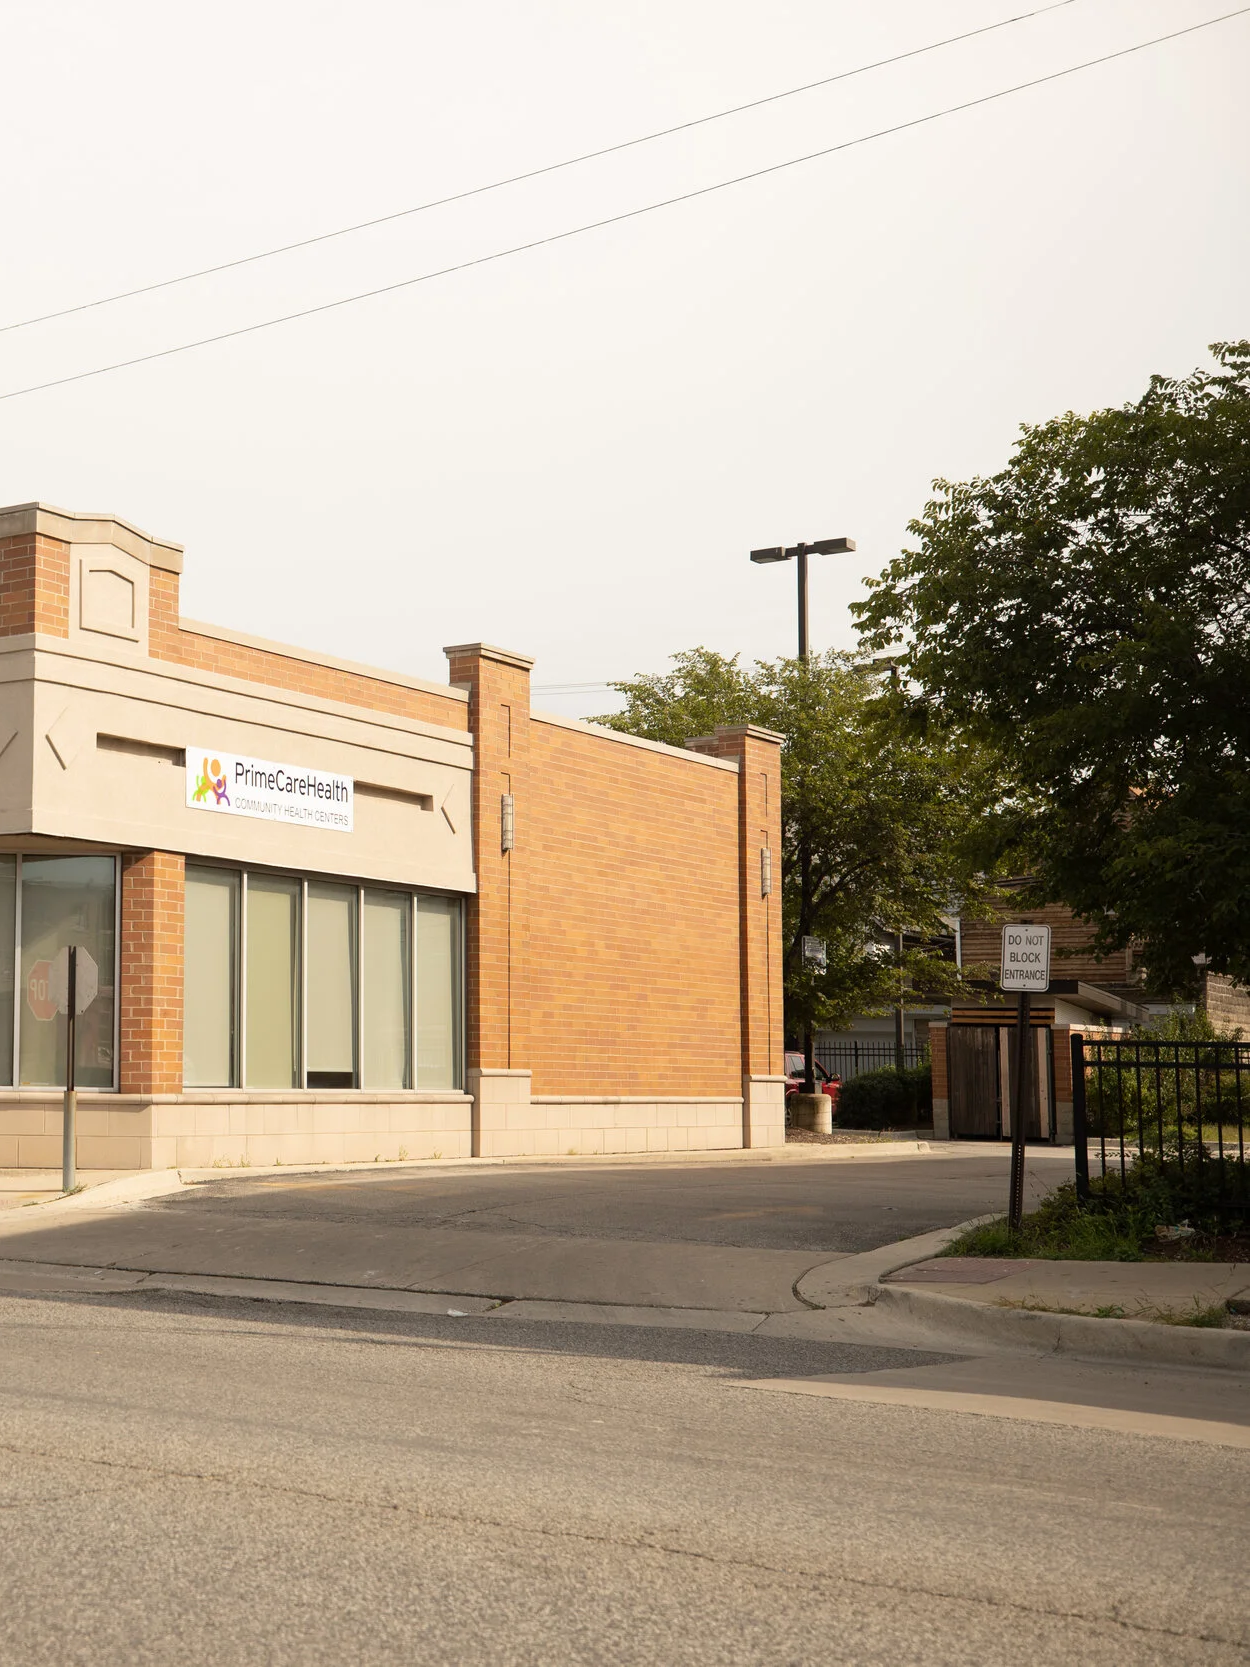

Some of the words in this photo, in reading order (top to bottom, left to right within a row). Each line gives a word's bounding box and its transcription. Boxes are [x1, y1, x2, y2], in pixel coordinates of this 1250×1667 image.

[235, 762, 349, 803] PrimeCareHealth
[235, 797, 283, 816] COMMUNITY
[284, 805, 313, 821] HEALTH
[314, 810, 349, 826] CENTERS
[1008, 934, 1022, 945] DO
[1025, 935, 1044, 946] NOT
[1009, 952, 1041, 963] BLOCK
[1004, 969, 1046, 981] ENTRANCE
